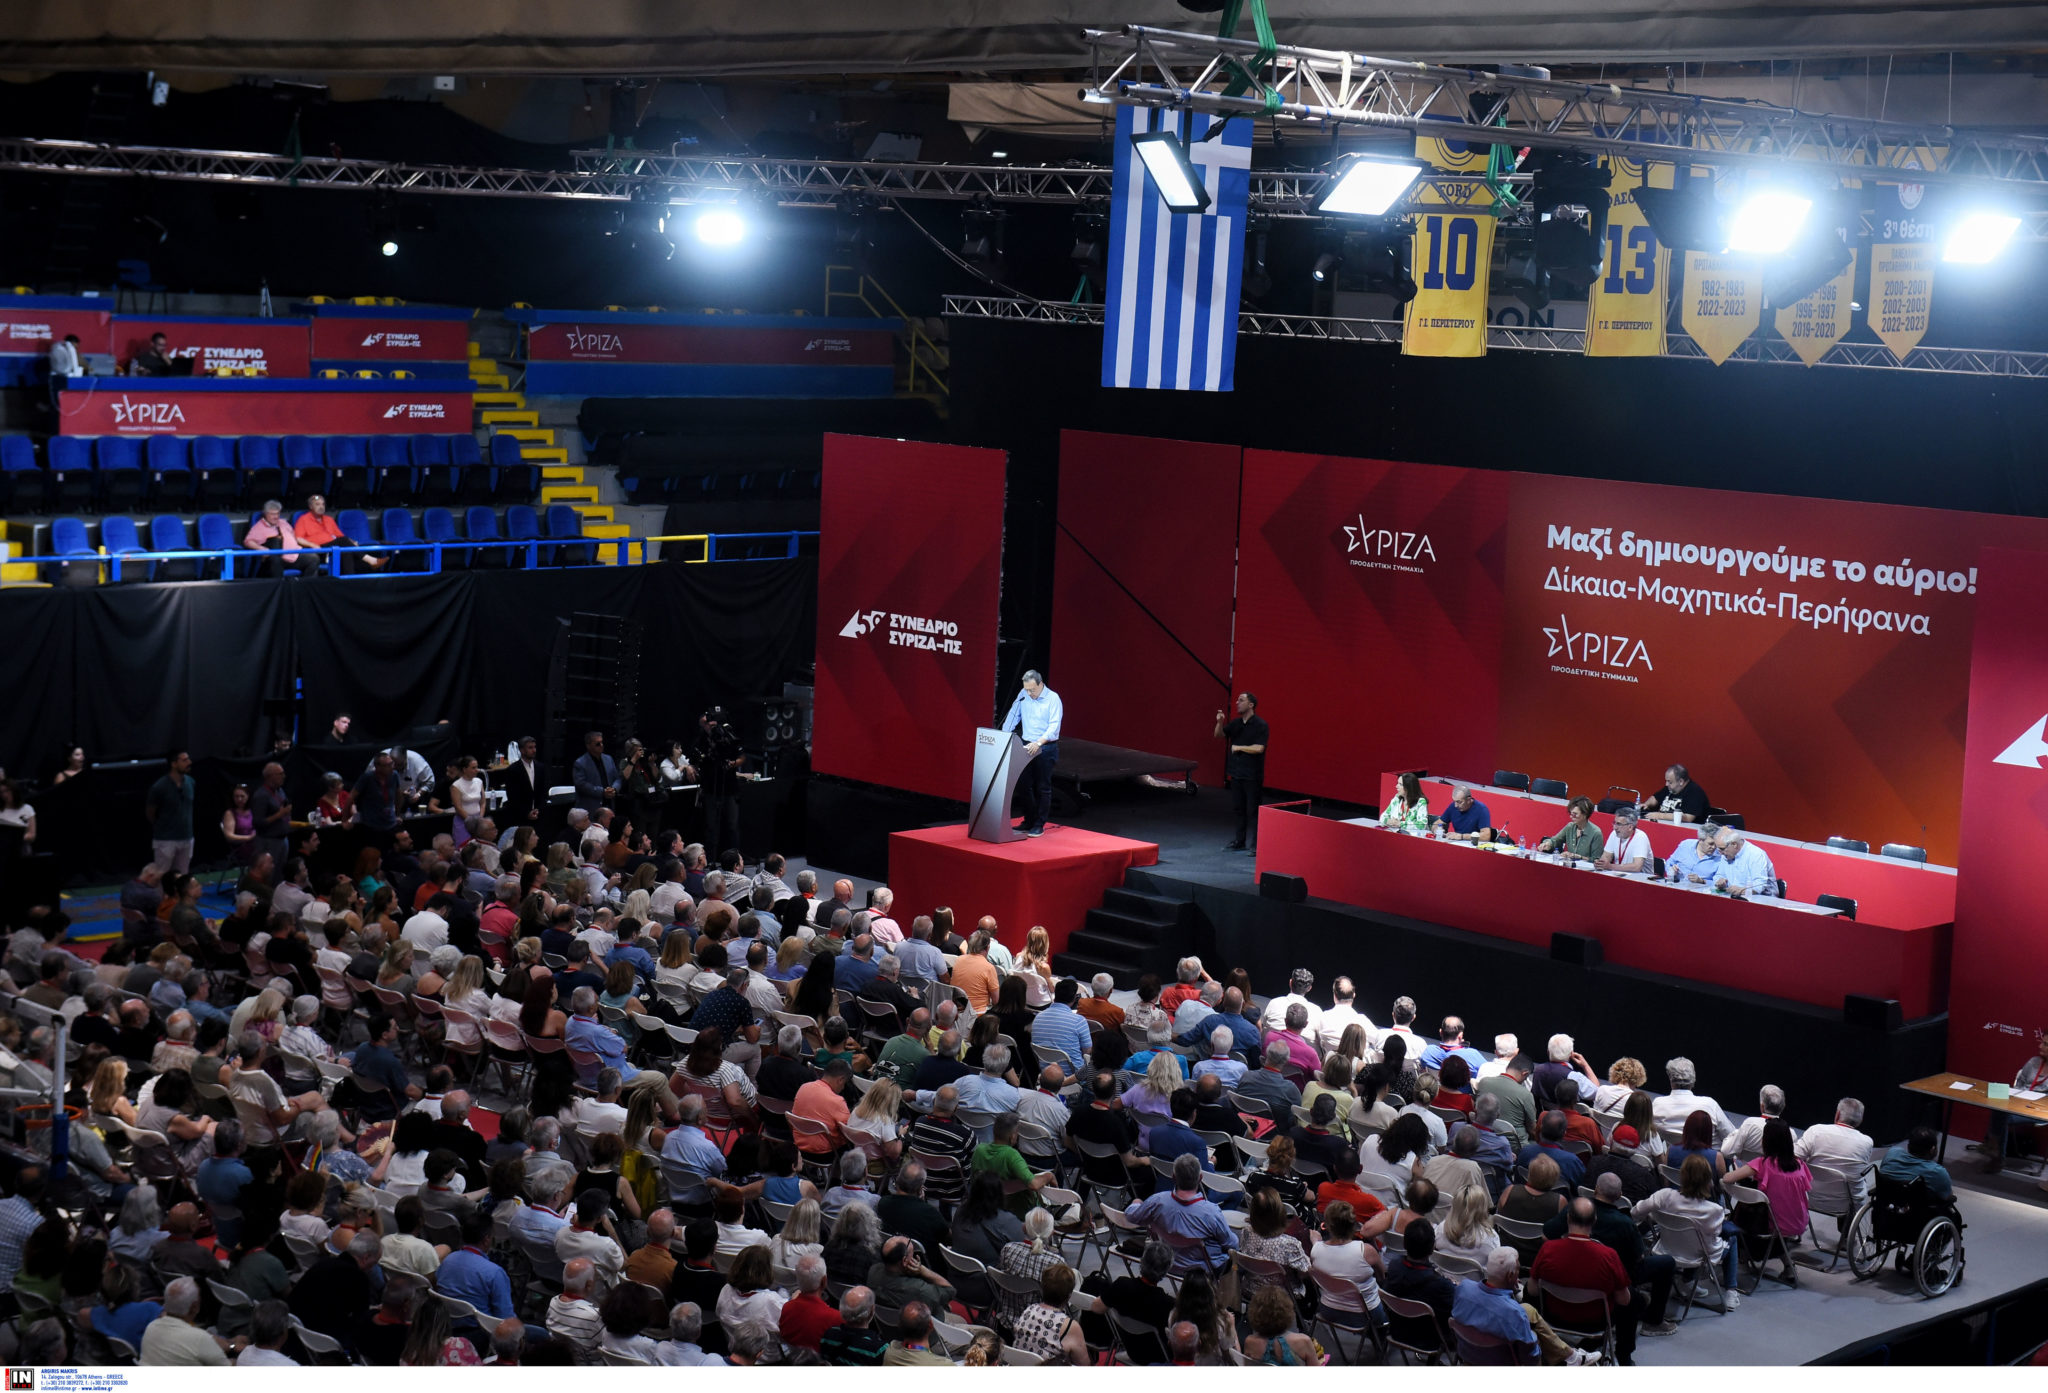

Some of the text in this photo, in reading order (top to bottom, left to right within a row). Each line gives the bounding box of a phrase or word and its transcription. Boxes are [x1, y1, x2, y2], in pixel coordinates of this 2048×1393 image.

[1423, 216, 1478, 290] 10
[1604, 225, 1657, 295] 13
[1702, 280, 1745, 297] 1982-1983
[1884, 280, 1927, 297] 2000-2001
[1697, 299, 1746, 316] 2022-2023
[1796, 303, 1836, 319] 1996-1997
[1882, 298, 1926, 314] 2002-2003
[1792, 321, 1836, 338] 2019-2020
[1881, 316, 1925, 333] 2022-2023
[204, 347, 264, 358] ΣΥΝΕΔΡΙΟ
[110, 394, 186, 423] ΣΥΡΙΖΑ
[1343, 513, 1437, 562] ΣΥΡΙΖΑ
[1350, 559, 1424, 574] ΠΡΟΟΔΕΥΤΙΚΗ ΣΥΜΜΑΧΙΑ
[1547, 524, 1978, 596] Μαζί δημιουργούμε το αύριο!
[1544, 566, 1931, 636] Δίκαια-Μαχητικά-Περήφανα
[889, 613, 958, 637] ΣΥΝΕΔΡΙΟ
[888, 630, 963, 655] ΣΥΡΙΖΑ-ΠΣ
[1542, 613, 1653, 671] ΣΥΡΙΖΑ
[1551, 665, 1639, 683] ΠΡΟΟΔΕΥΤΙΚΗ ΣΥΜΜΑΧΙΑ
